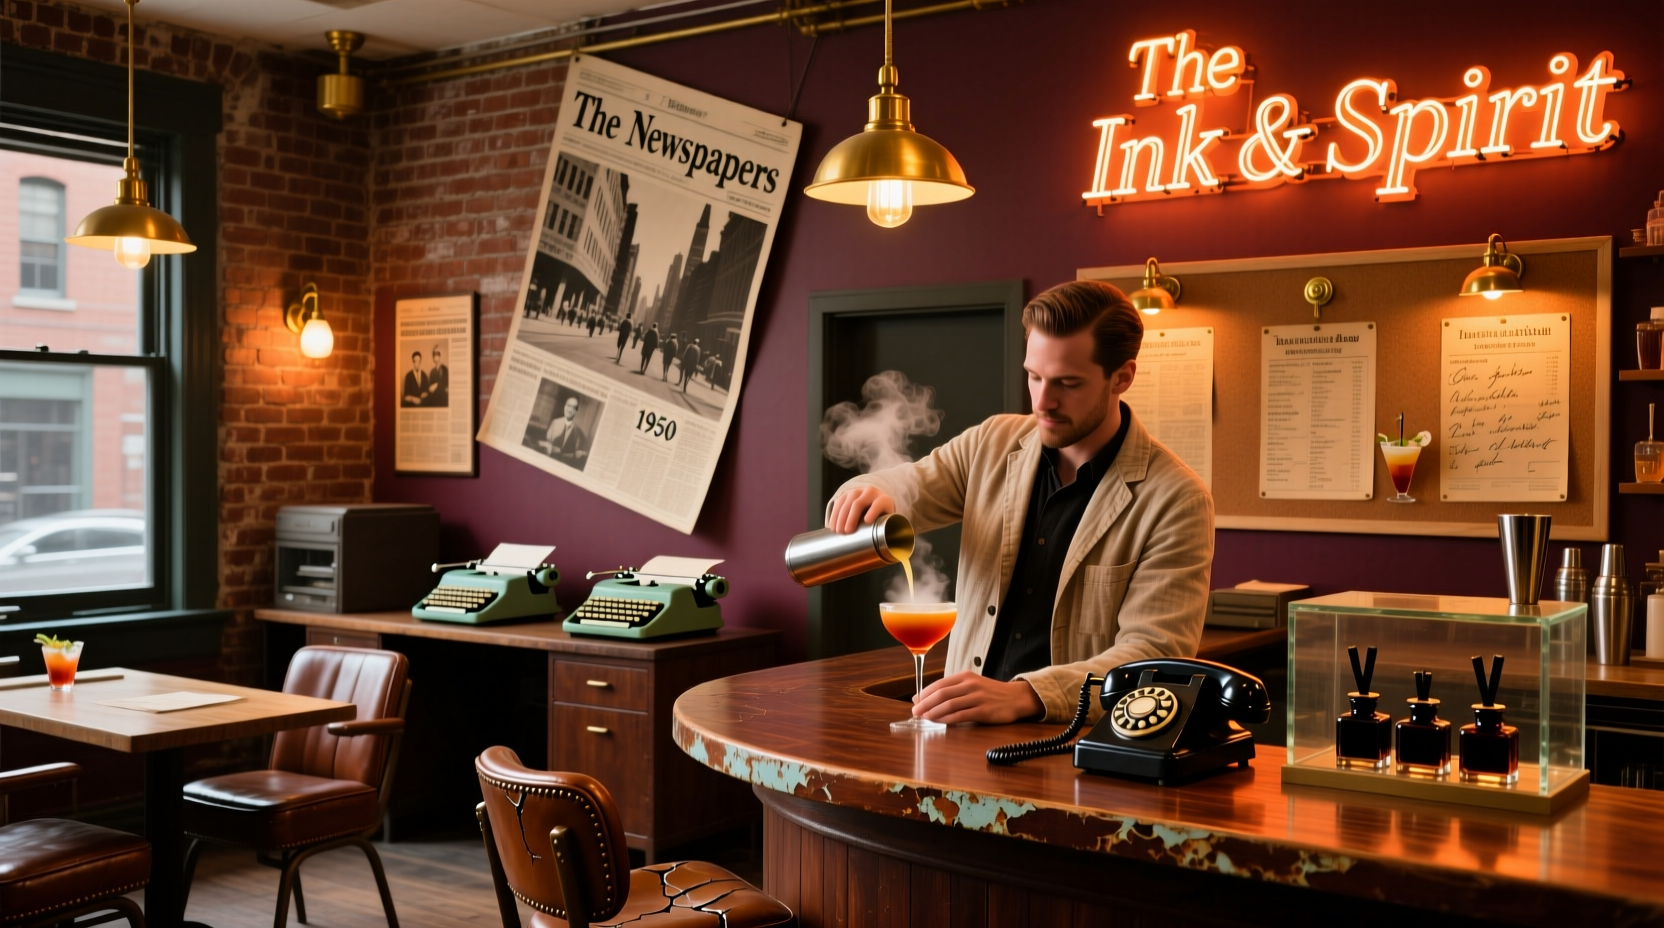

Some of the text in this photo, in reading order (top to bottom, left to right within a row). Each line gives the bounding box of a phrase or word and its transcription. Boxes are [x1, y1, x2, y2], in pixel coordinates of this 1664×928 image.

[1128, 30, 1243, 104] The
[572, 90, 780, 194] The Newspapers
[1081, 54, 1619, 200] Ink & Spirit
[635, 408, 677, 442] 1950
